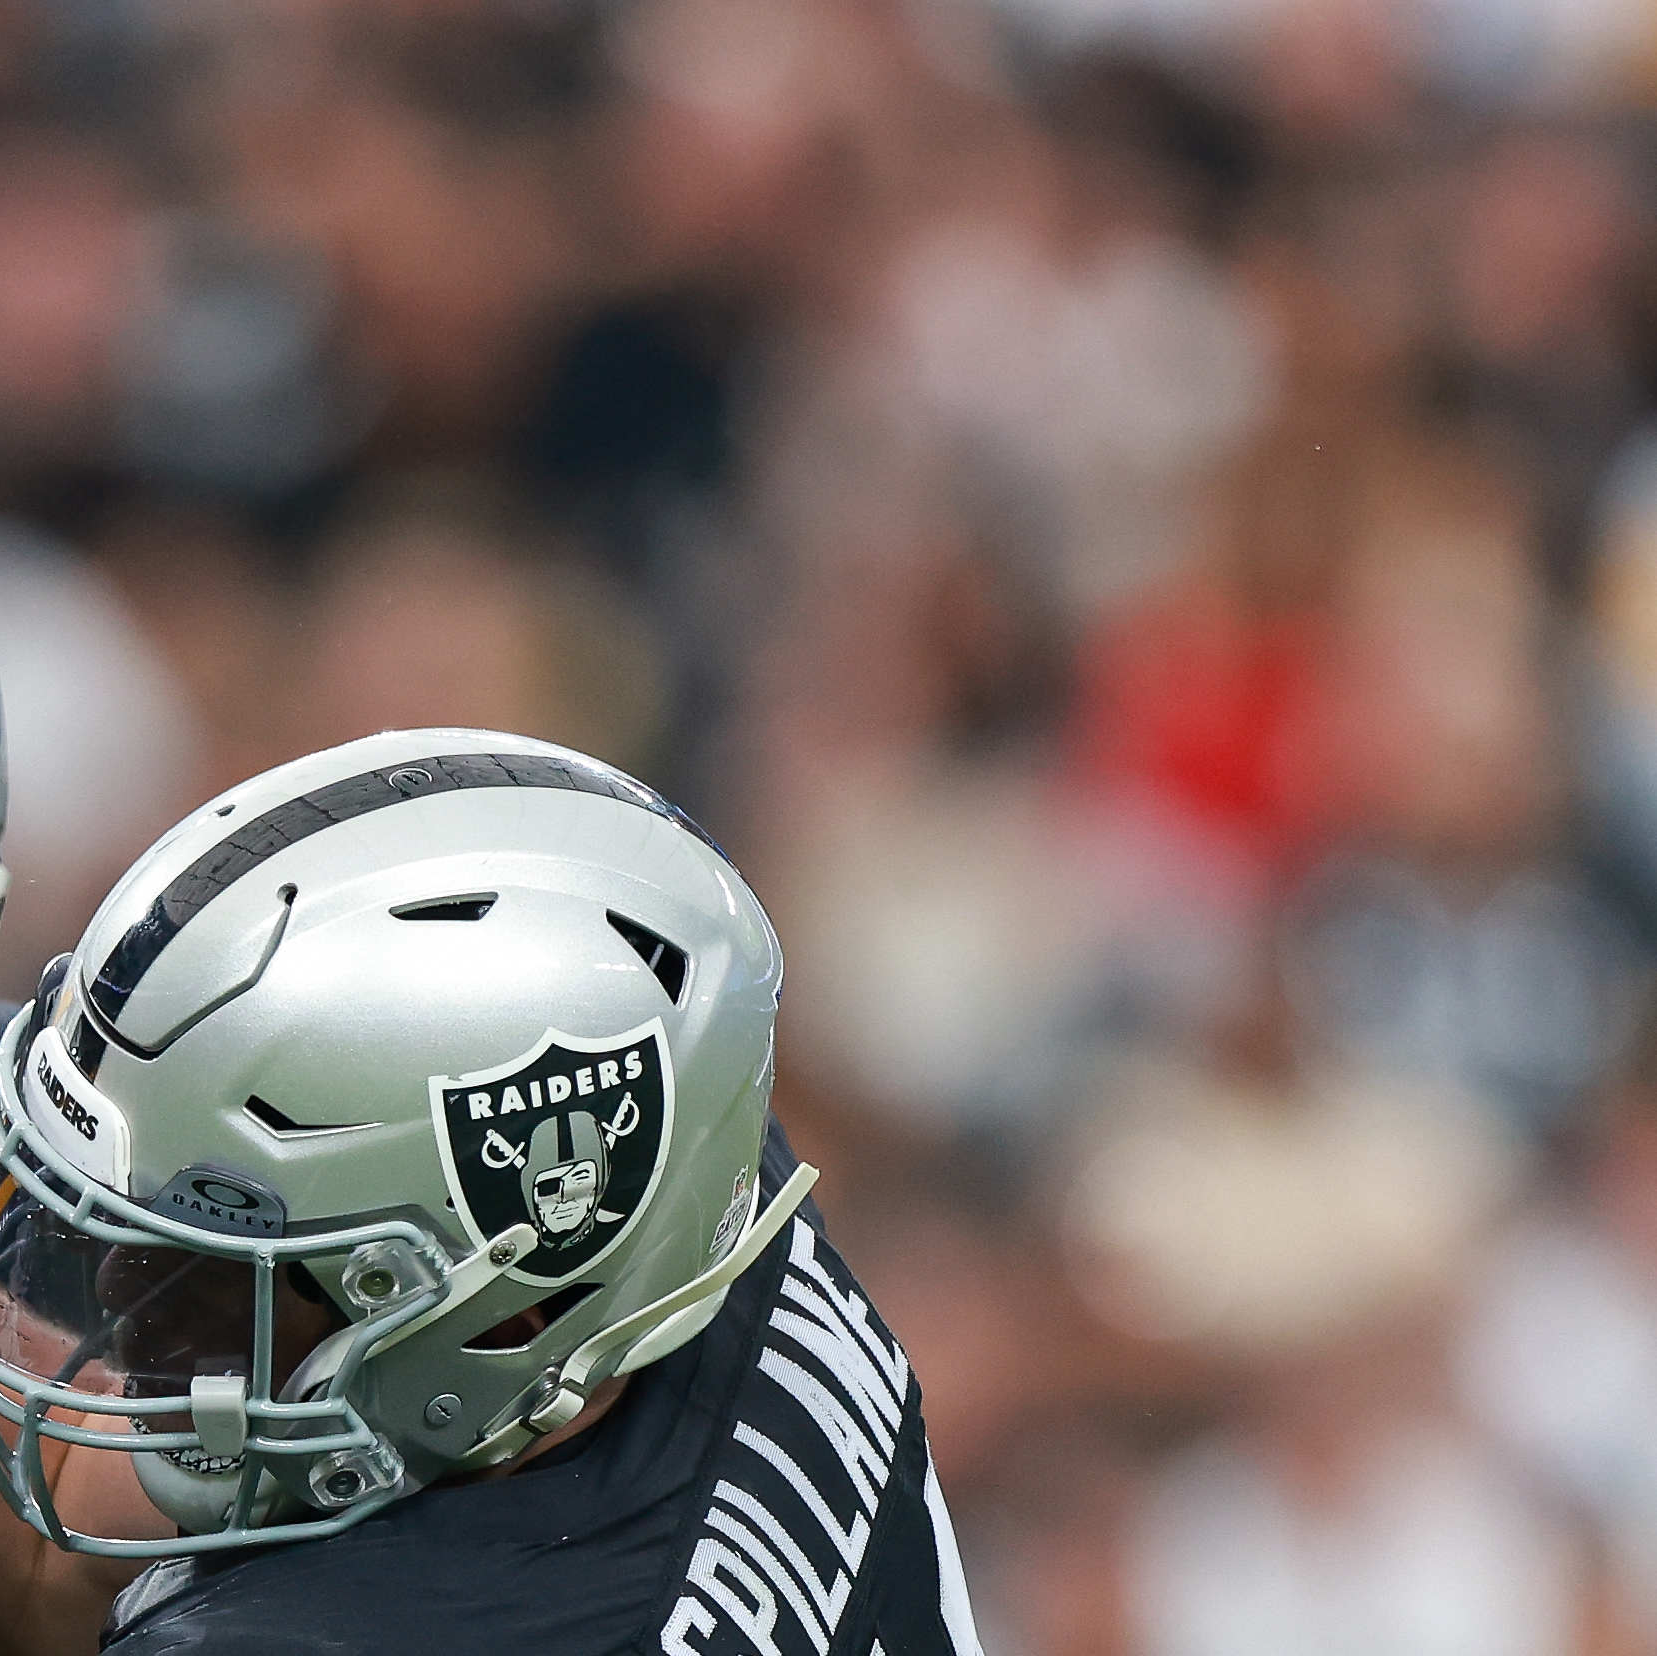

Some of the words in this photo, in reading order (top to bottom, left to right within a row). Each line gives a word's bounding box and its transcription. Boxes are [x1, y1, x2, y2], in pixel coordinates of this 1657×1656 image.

[35, 1051, 99, 1142] RAIDERS
[467, 1050, 644, 1121] RAIDERS
[172, 1192, 275, 1231] OAKLEY
